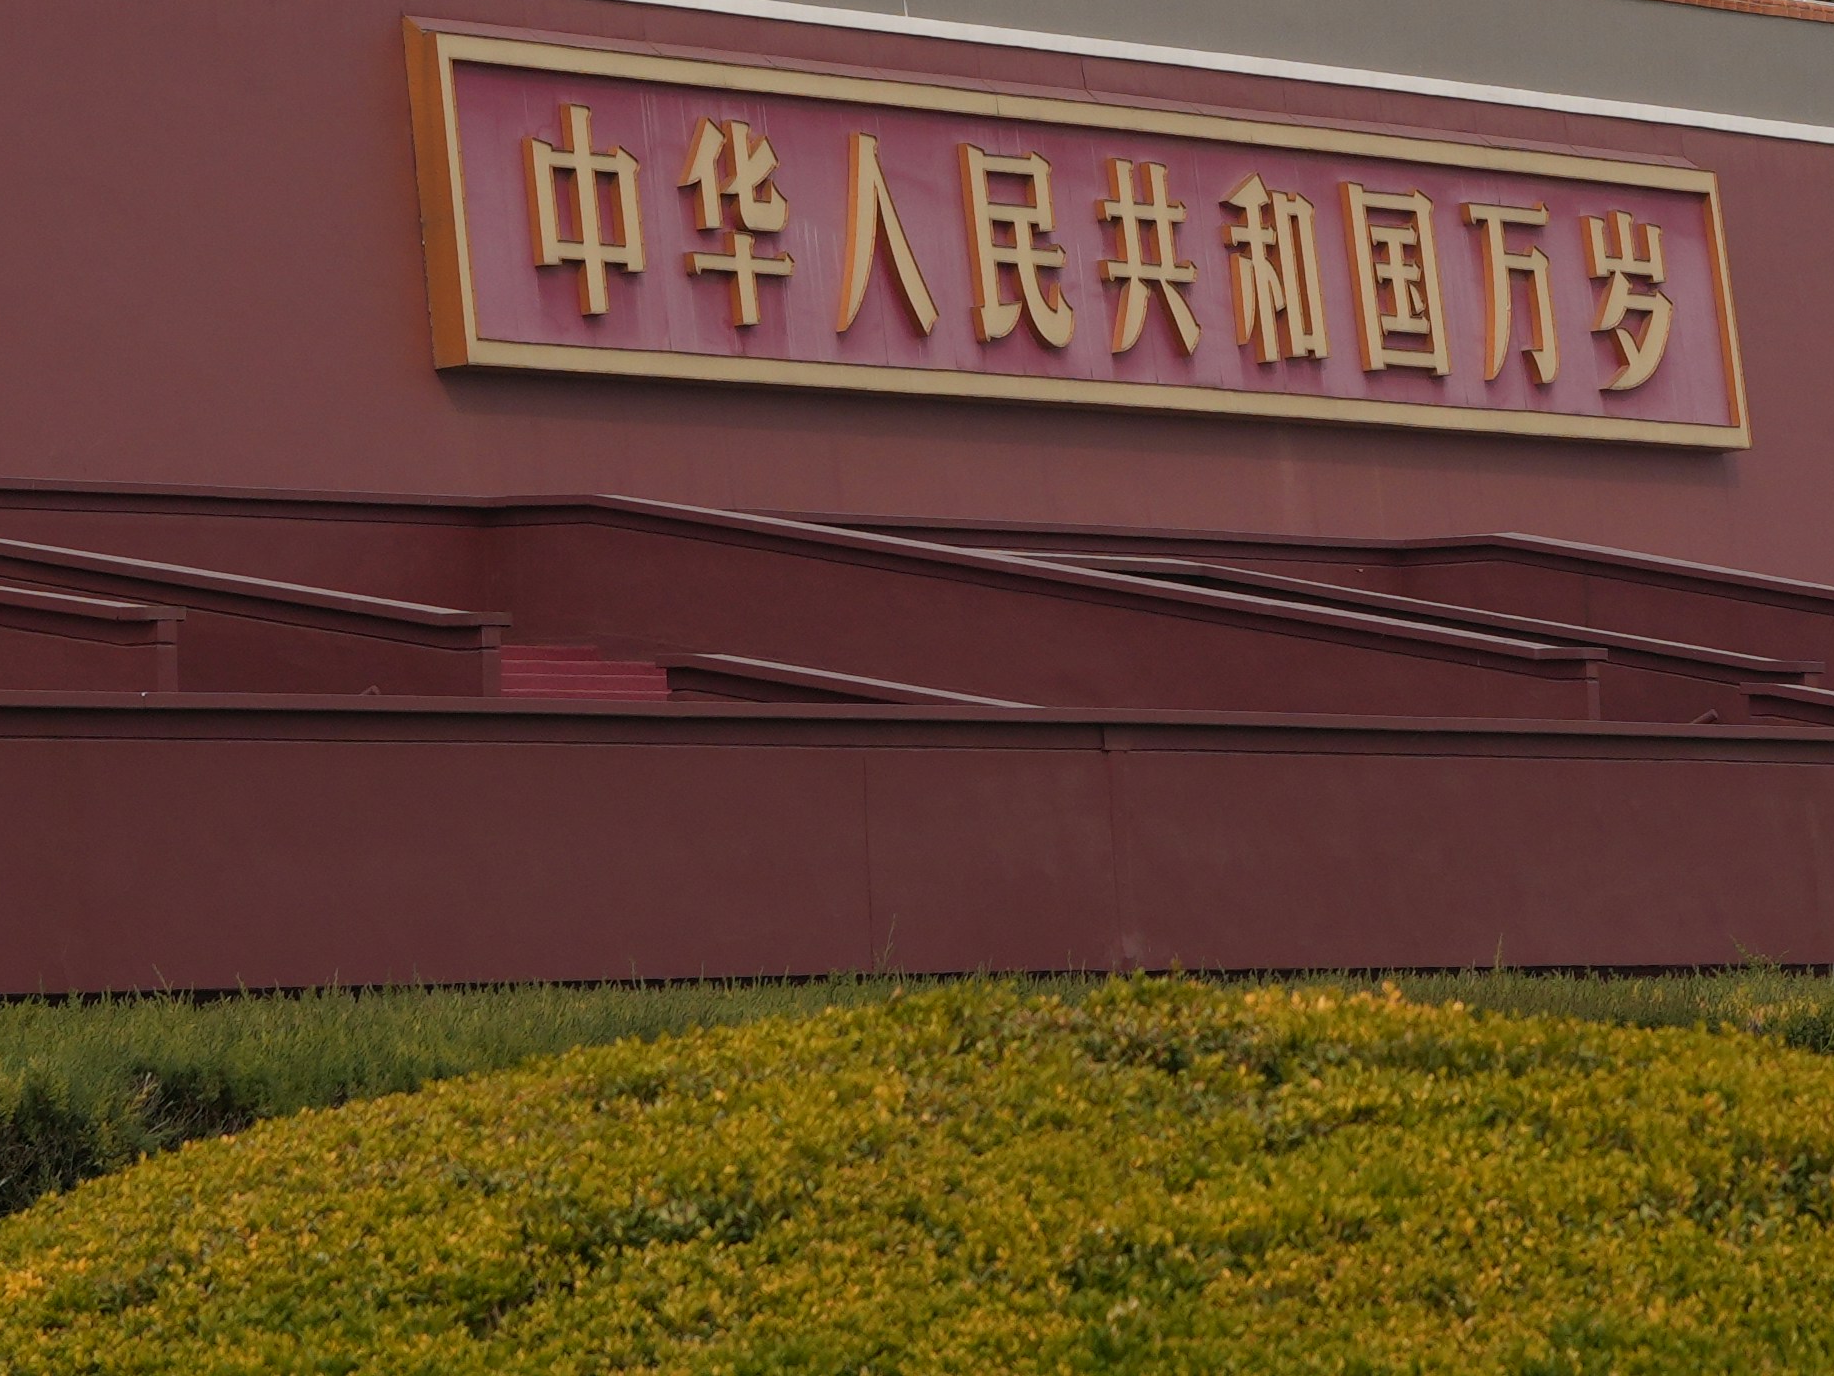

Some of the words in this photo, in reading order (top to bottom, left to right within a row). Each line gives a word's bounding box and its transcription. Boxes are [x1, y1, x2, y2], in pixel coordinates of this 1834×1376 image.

[529, 104, 1673, 391] 中华人民共和国万岁
